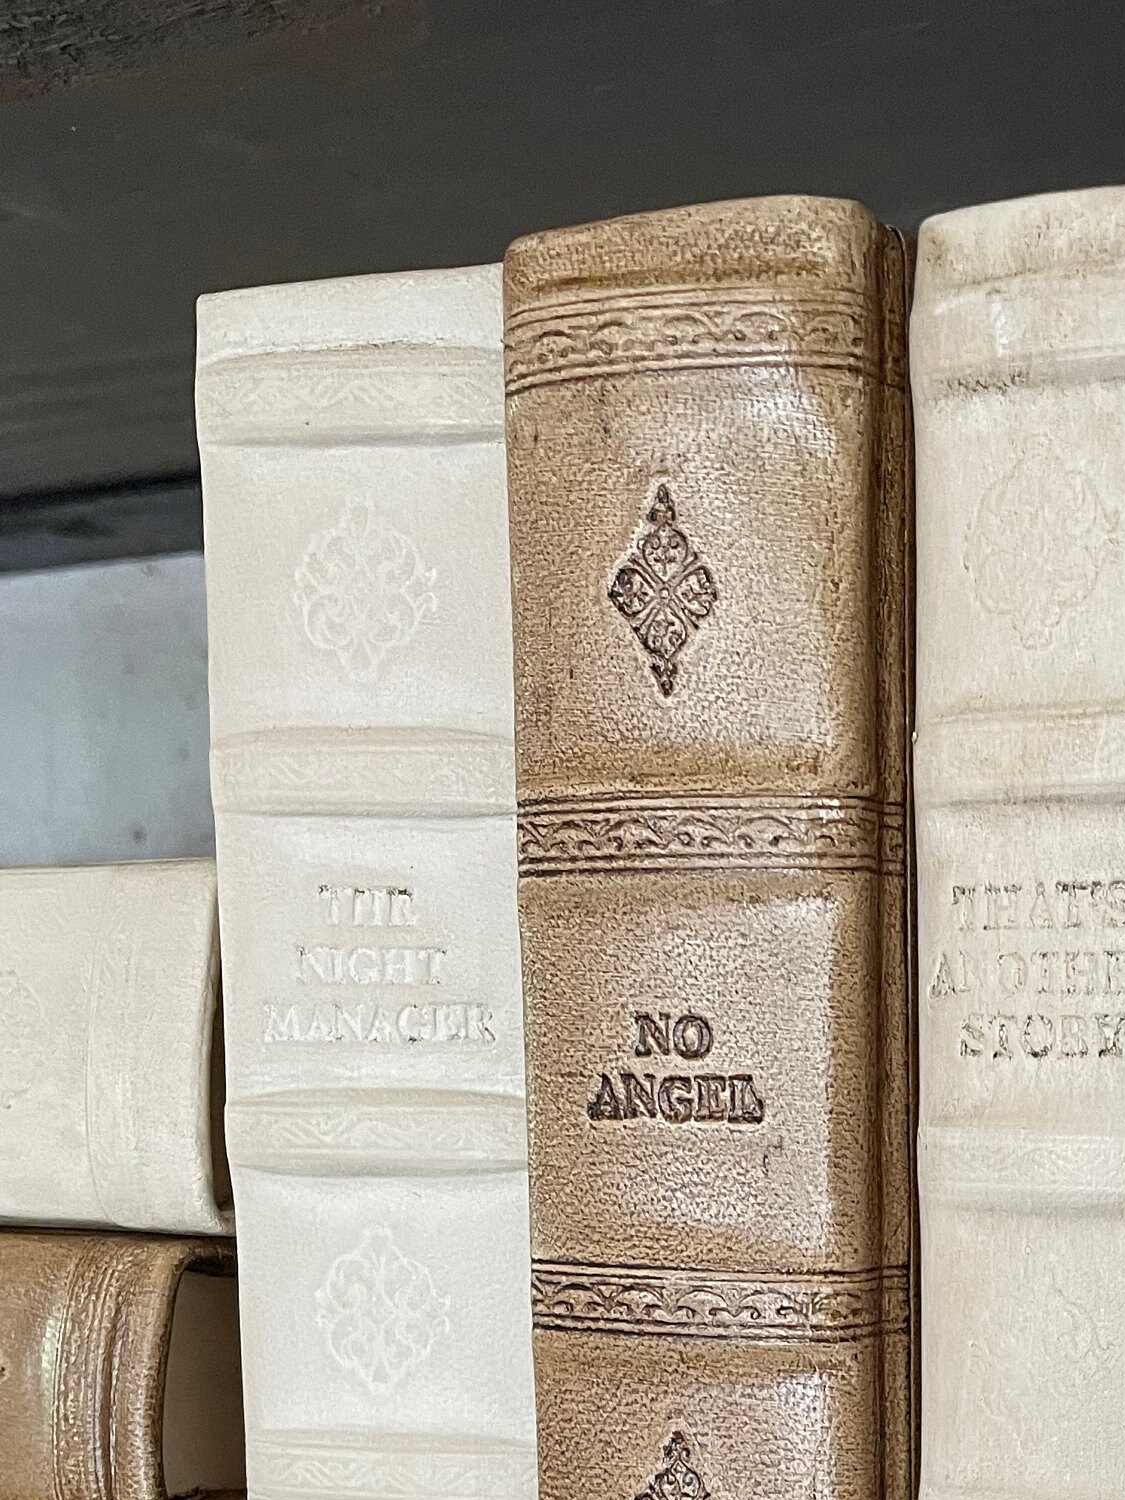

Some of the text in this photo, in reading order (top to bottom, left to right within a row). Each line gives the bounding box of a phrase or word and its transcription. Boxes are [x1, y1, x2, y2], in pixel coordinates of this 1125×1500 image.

[294, 942, 448, 987] NIGHT
[260, 1000, 498, 1046] MANAGER
[633, 1011, 715, 1061] NO
[586, 1072, 766, 1125] ANGEL
